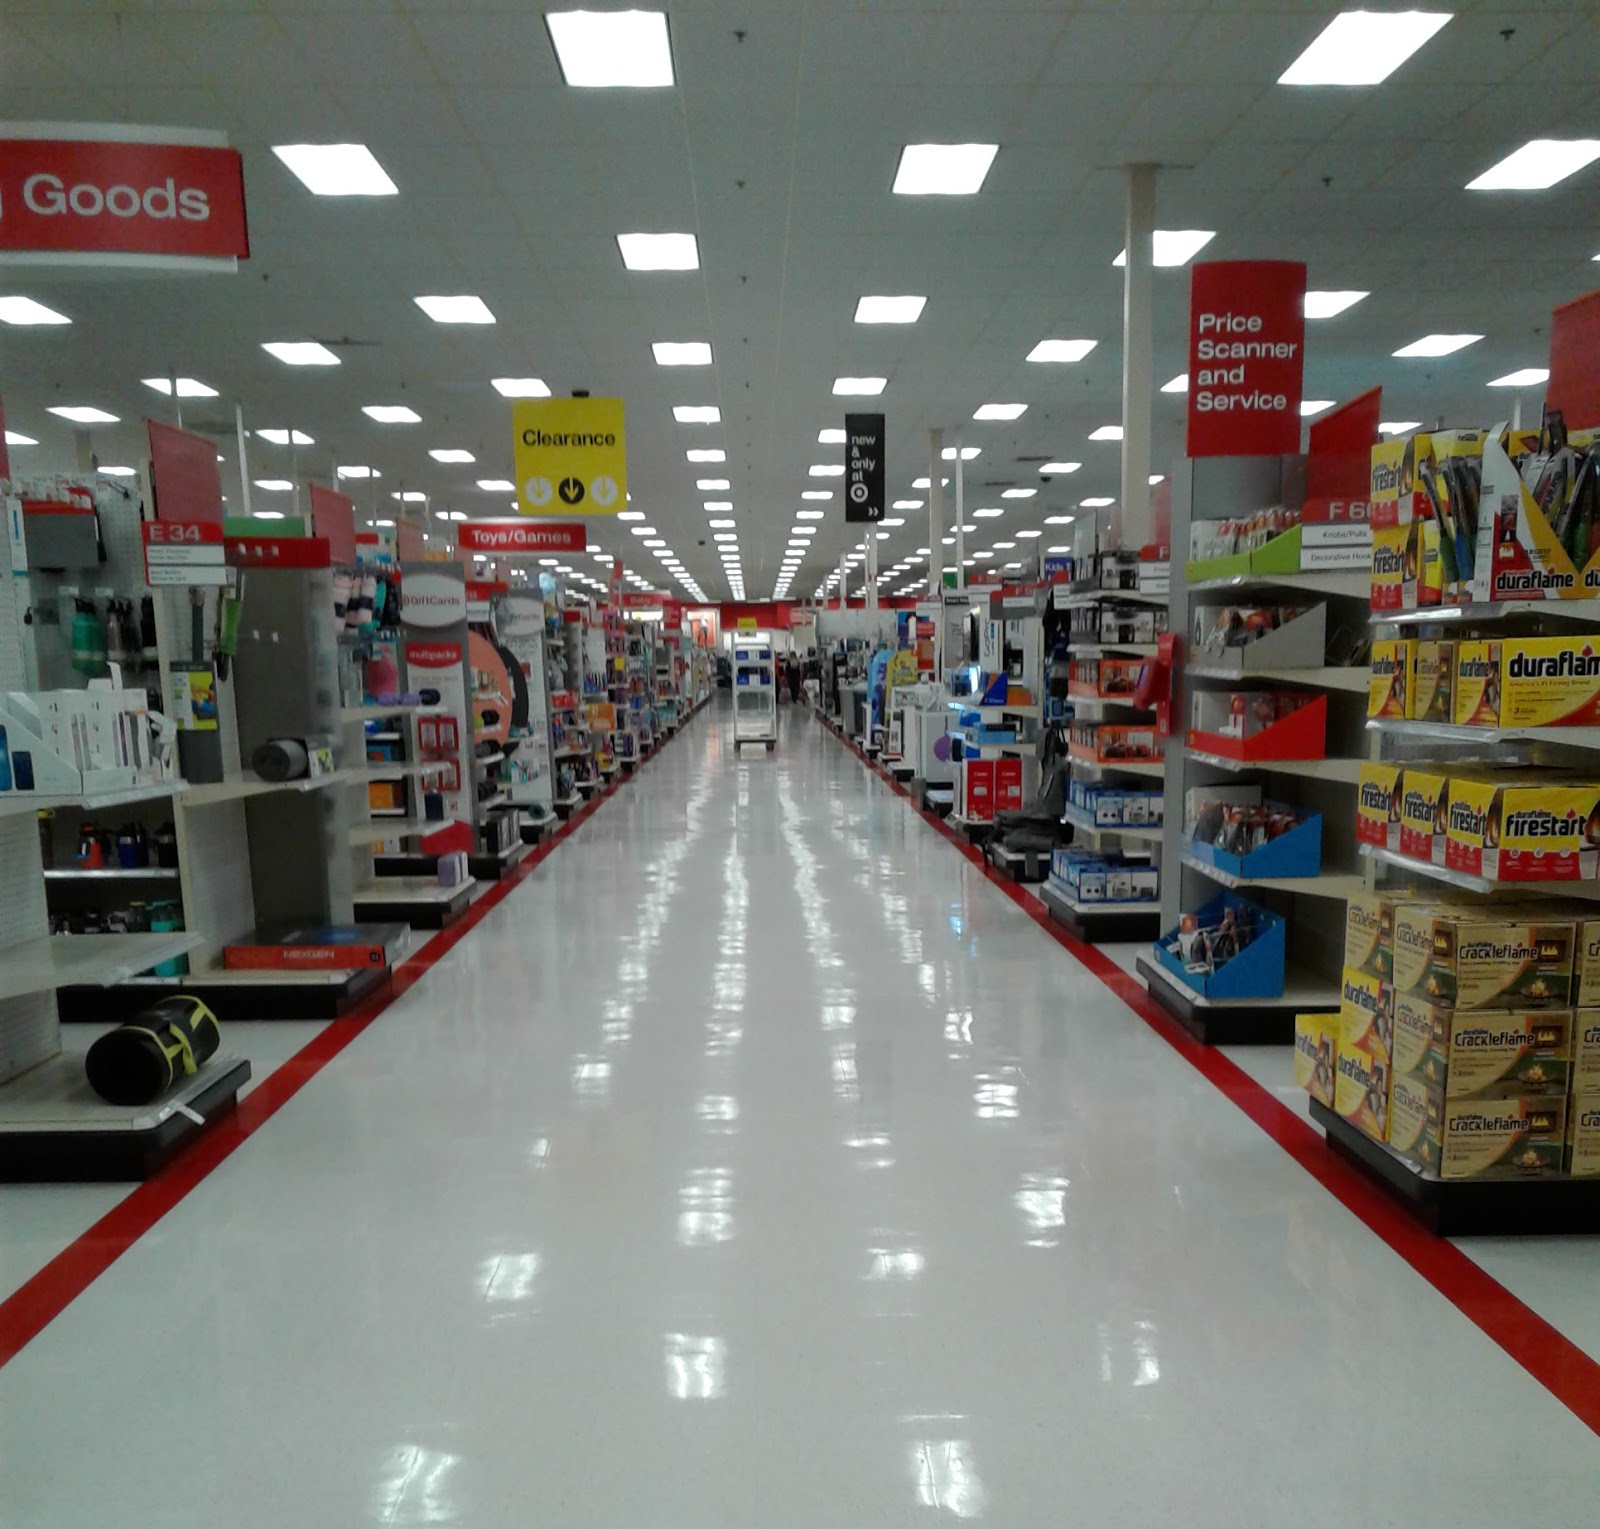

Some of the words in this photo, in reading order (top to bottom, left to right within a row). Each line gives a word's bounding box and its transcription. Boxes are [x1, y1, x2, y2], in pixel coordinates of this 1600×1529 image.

[24, 173, 210, 221] Goods
[1199, 313, 1262, 333] Price
[1198, 340, 1297, 360] Scanner
[1198, 365, 1244, 386] and
[1196, 390, 1287, 411] Service
[522, 429, 616, 446] Clearance
[851, 436, 876, 445] new
[852, 446, 860, 458] &
[851, 458, 875, 471] only
[852, 471, 863, 481] at
[1330, 502, 1345, 520] F
[150, 525, 164, 542] E
[169, 525, 200, 541] 34
[473, 529, 571, 546] Toys/Games
[1497, 570, 1573, 590] duraflame
[410, 649, 457, 660] multipacks
[1451, 803, 1487, 836] firestart
[1506, 814, 1587, 837] firestart
[1460, 945, 1538, 960] Crackleflame
[1455, 1032, 1535, 1047] Crackleflame
[1449, 1117, 1529, 1132] Crackleflame
